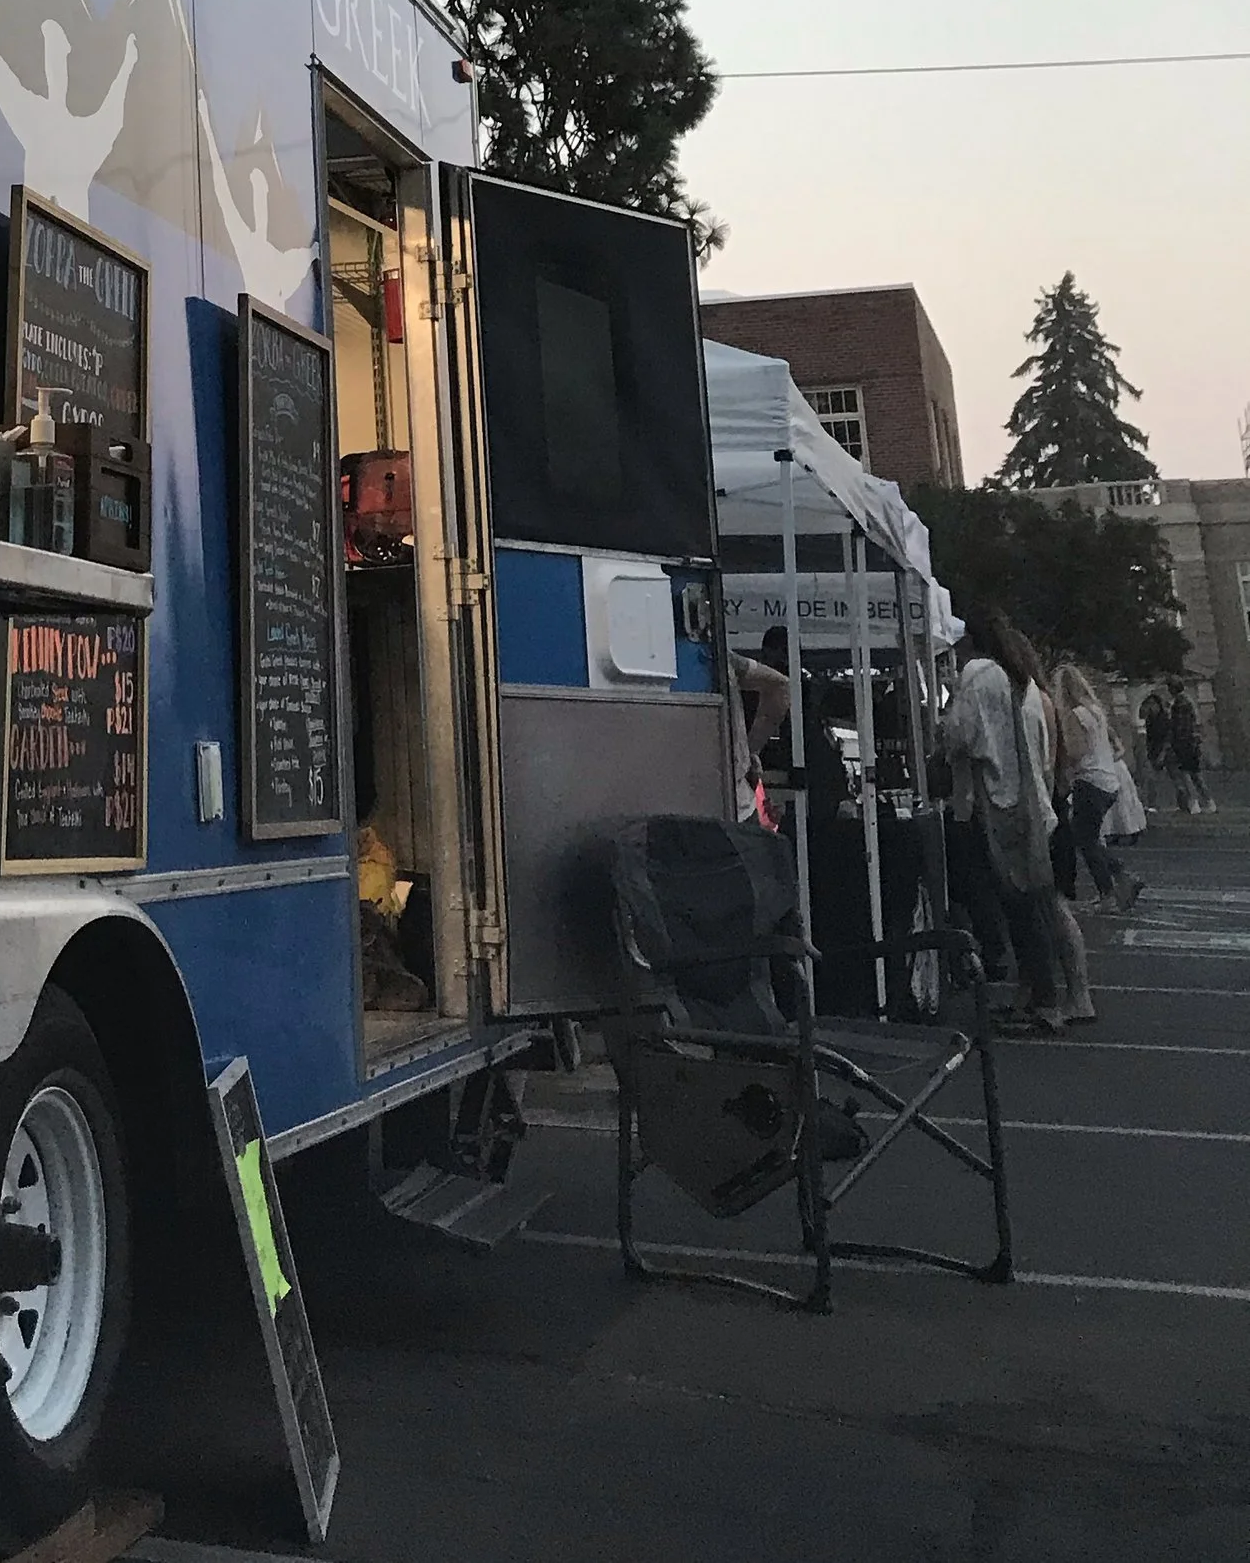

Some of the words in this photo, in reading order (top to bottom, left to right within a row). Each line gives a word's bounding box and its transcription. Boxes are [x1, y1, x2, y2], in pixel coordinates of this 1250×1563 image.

[78, 264, 93, 288] THE
[115, 670, 134, 705] $15
[107, 703, 133, 735] P$21
[105, 789, 135, 831] P$21
